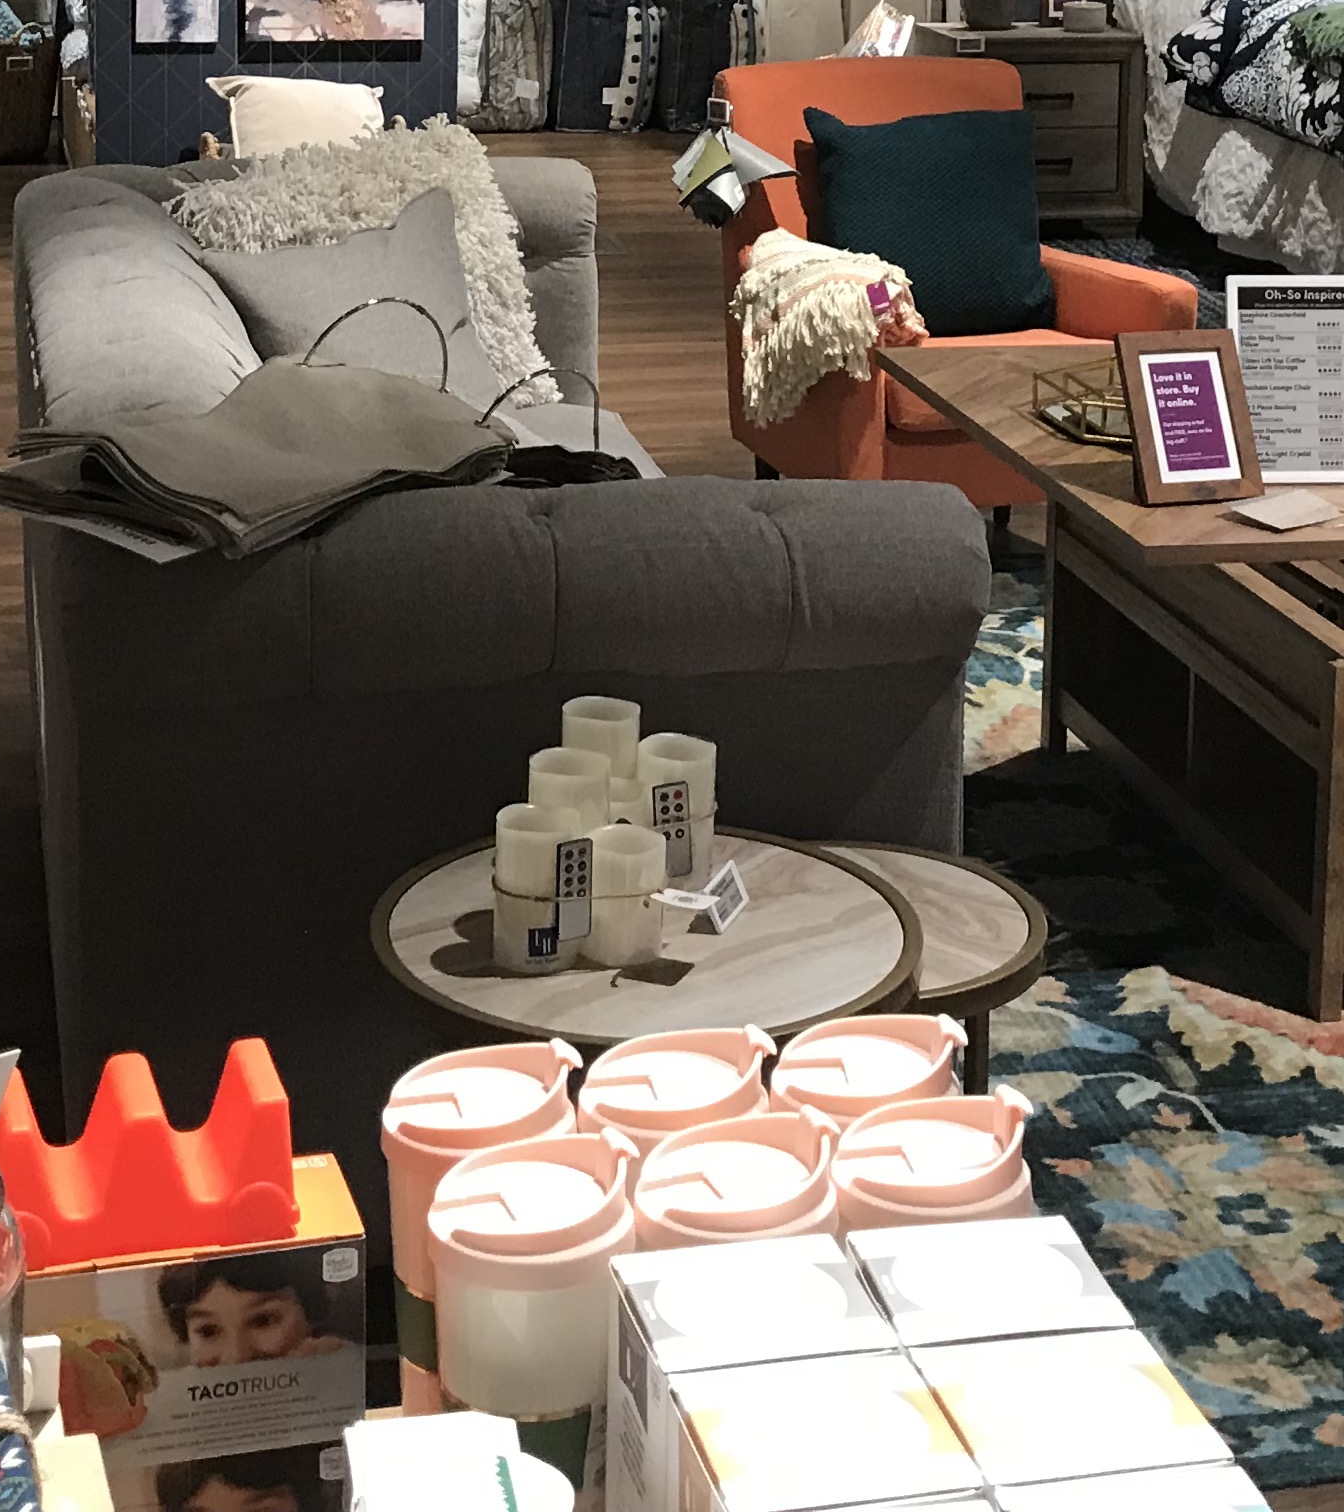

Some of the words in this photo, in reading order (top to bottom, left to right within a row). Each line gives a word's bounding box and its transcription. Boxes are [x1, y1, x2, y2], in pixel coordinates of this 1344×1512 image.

[1264, 289, 1302, 300] Oh-So
[1153, 373, 1174, 383] Love
[1175, 372, 1182, 381] it
[1183, 371, 1192, 380] in
[1156, 386, 1181, 395] store.
[1182, 385, 1199, 395] Buy
[1158, 399, 1166, 408] it
[1167, 398, 1197, 407] online.
[187, 1371, 300, 1402] TACOTRUCK
